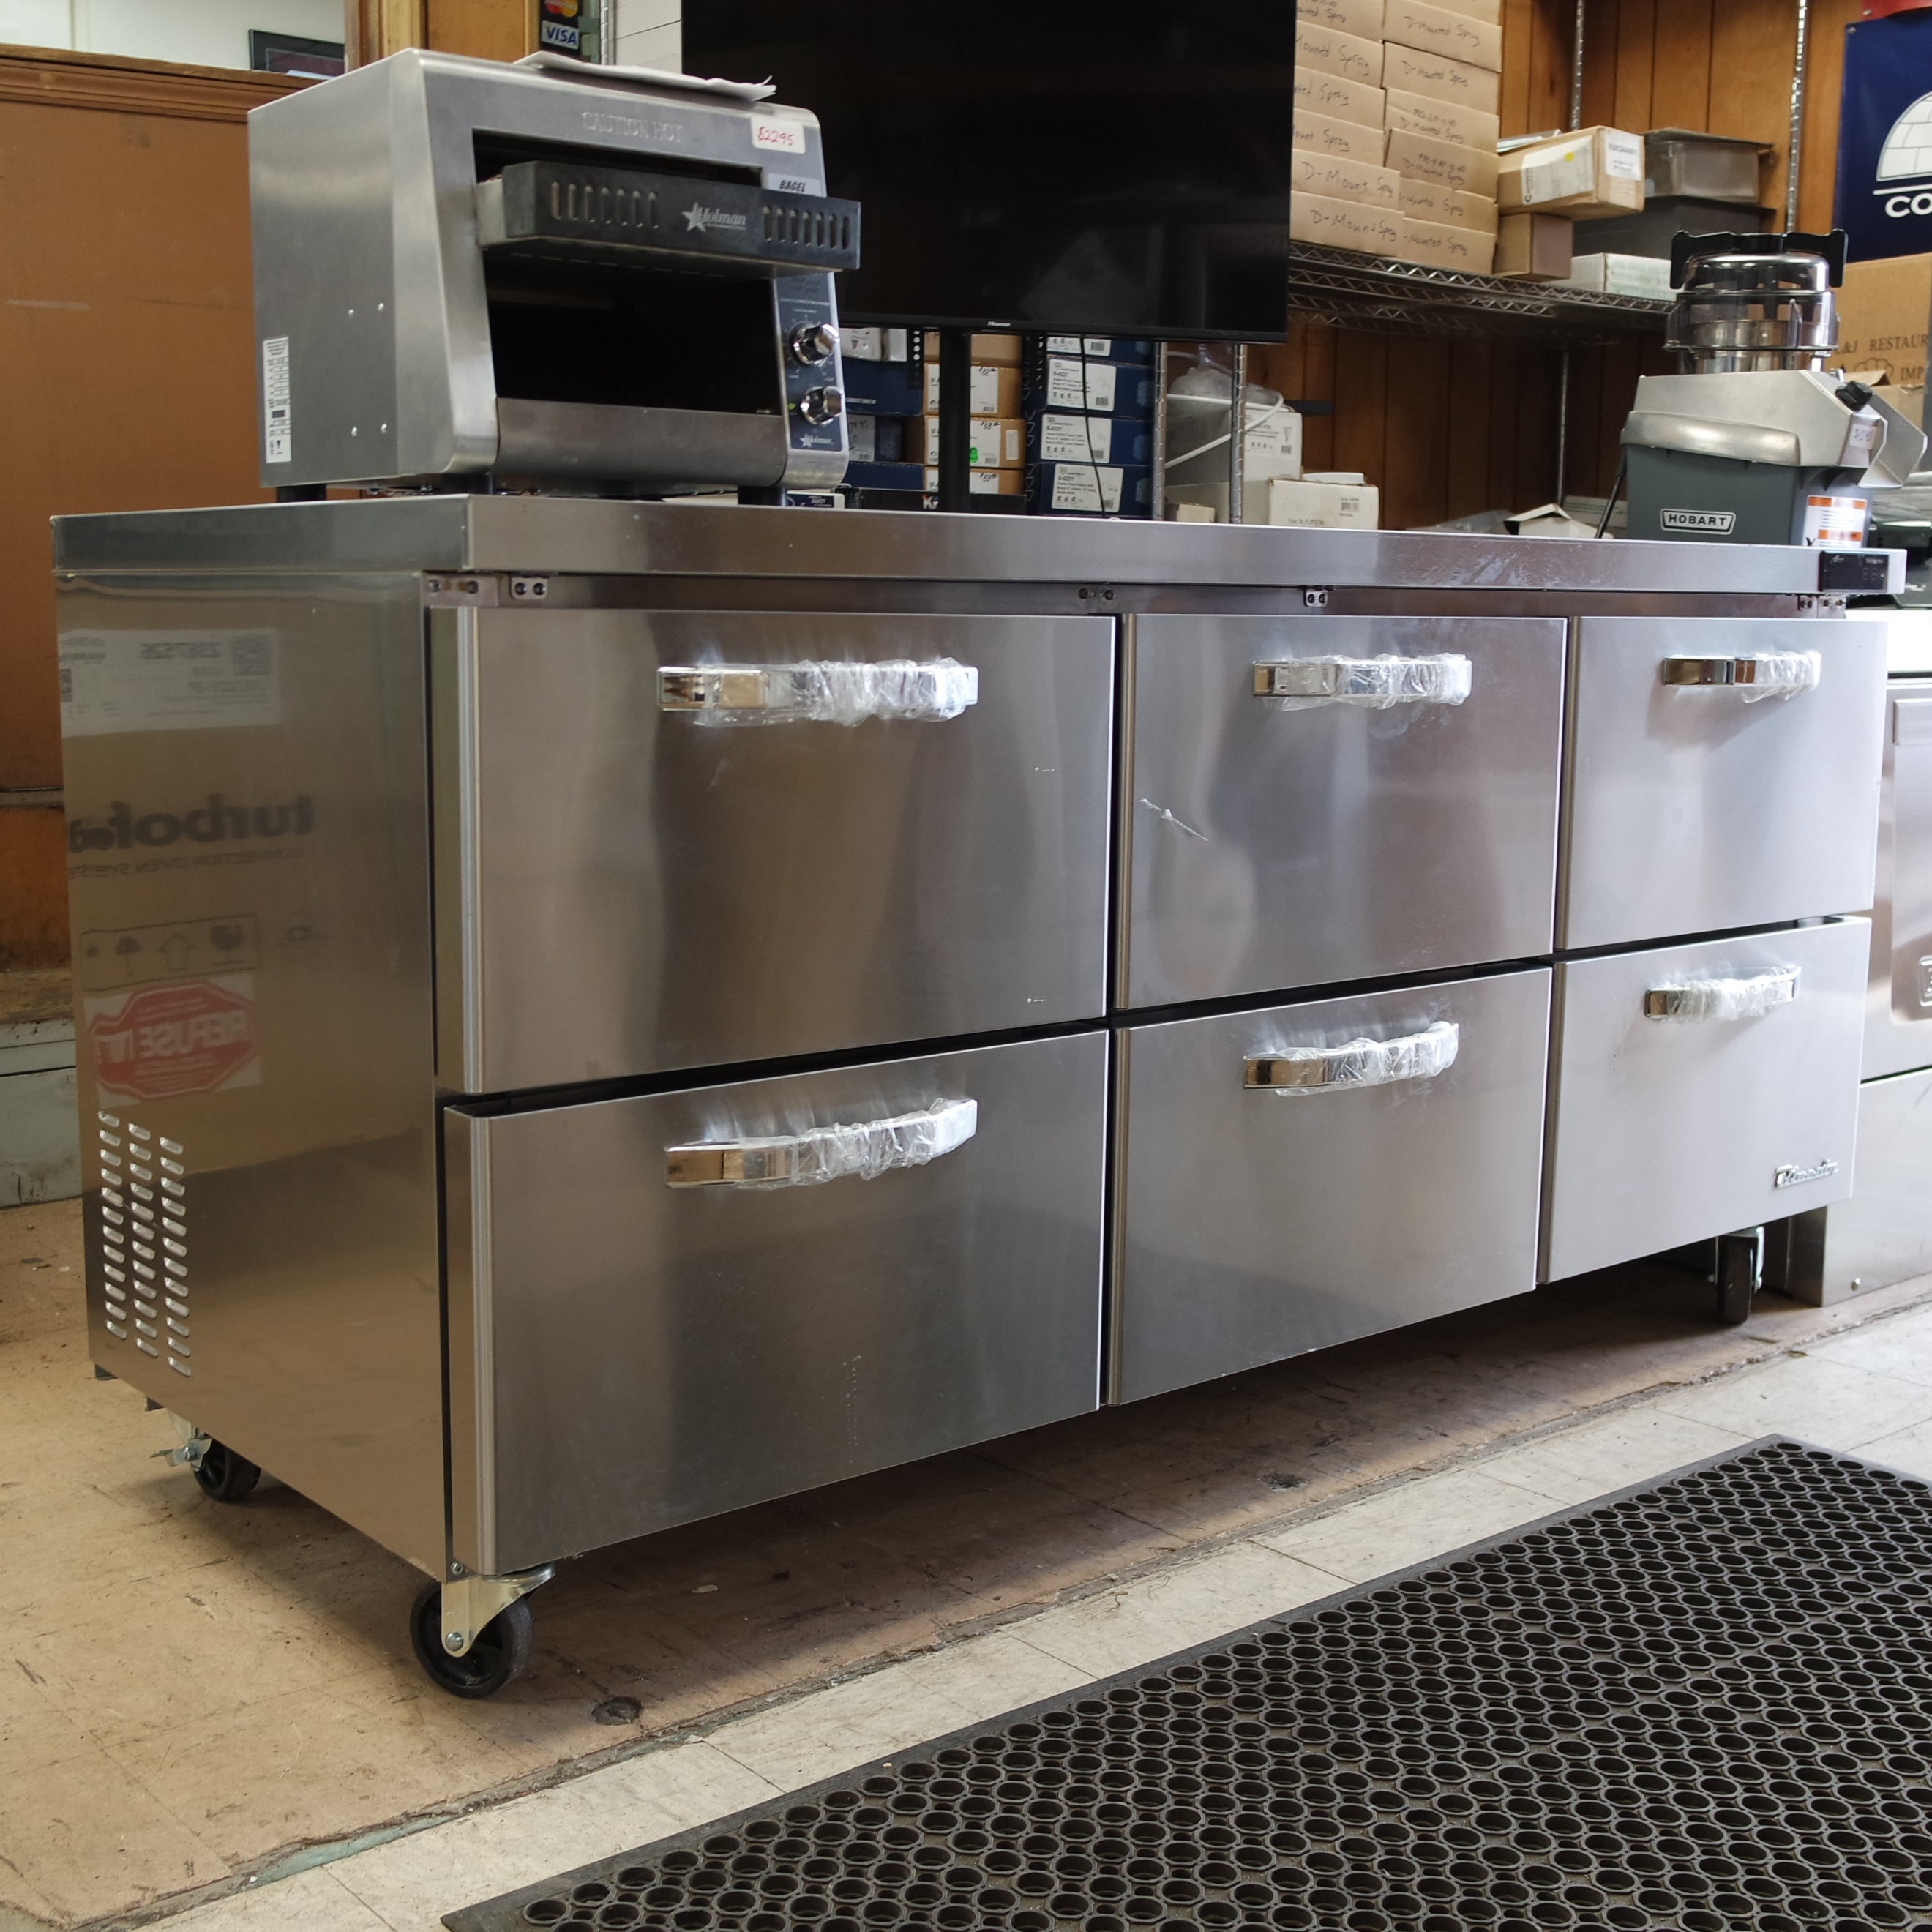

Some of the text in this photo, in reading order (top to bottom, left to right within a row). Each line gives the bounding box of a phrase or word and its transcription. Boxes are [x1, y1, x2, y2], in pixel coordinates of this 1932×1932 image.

[547, 26, 577, 45] VISA
[1457, 23, 1480, 47] Spray
[1338, 45, 1370, 76] Spray
[1320, 83, 1349, 107] Spray
[582, 111, 684, 143] CAUTION HOT
[1323, 128, 1350, 152] Spray
[779, 180, 806, 193] BAGEL
[1884, 192, 1932, 218] CO
[1668, 514, 1727, 526] HOBART
